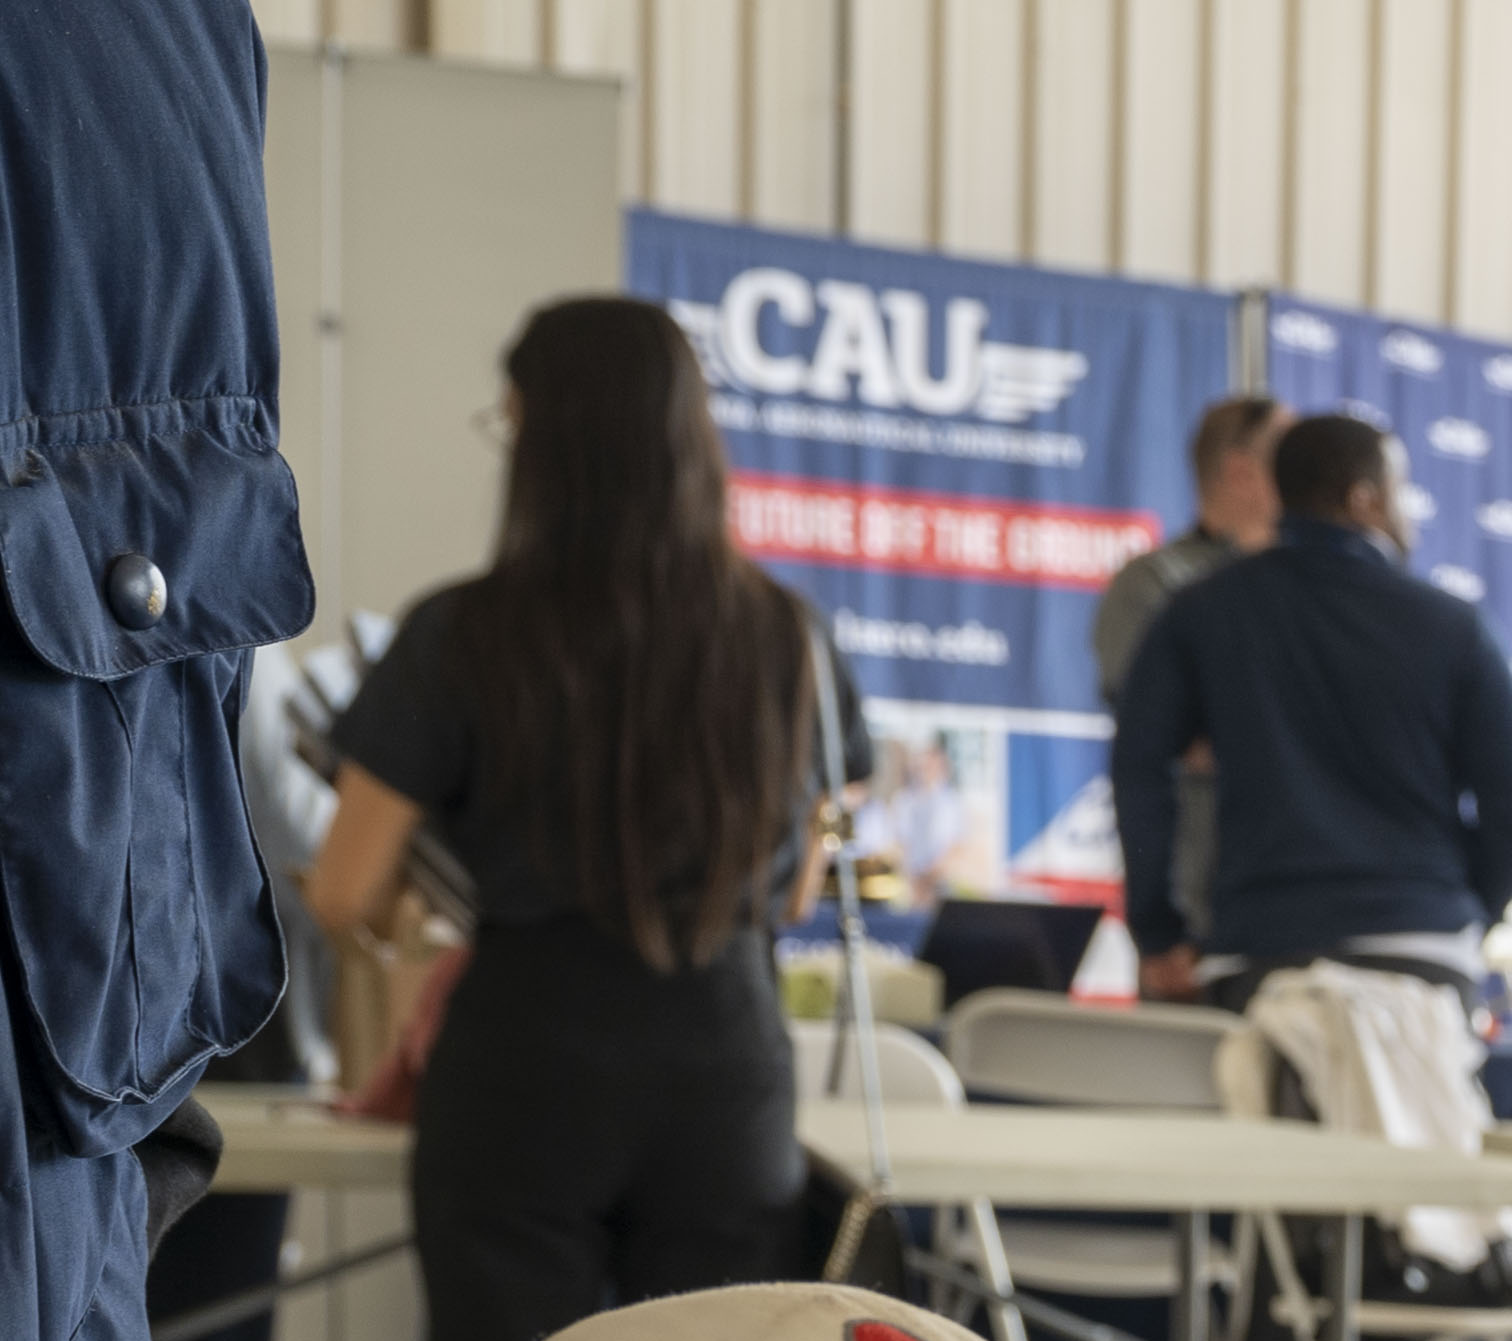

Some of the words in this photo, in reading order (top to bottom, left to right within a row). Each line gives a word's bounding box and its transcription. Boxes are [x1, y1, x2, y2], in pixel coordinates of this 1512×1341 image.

[721, 265, 990, 416] CAU
[728, 483, 857, 557] UTURE
[934, 507, 1000, 570] THE
